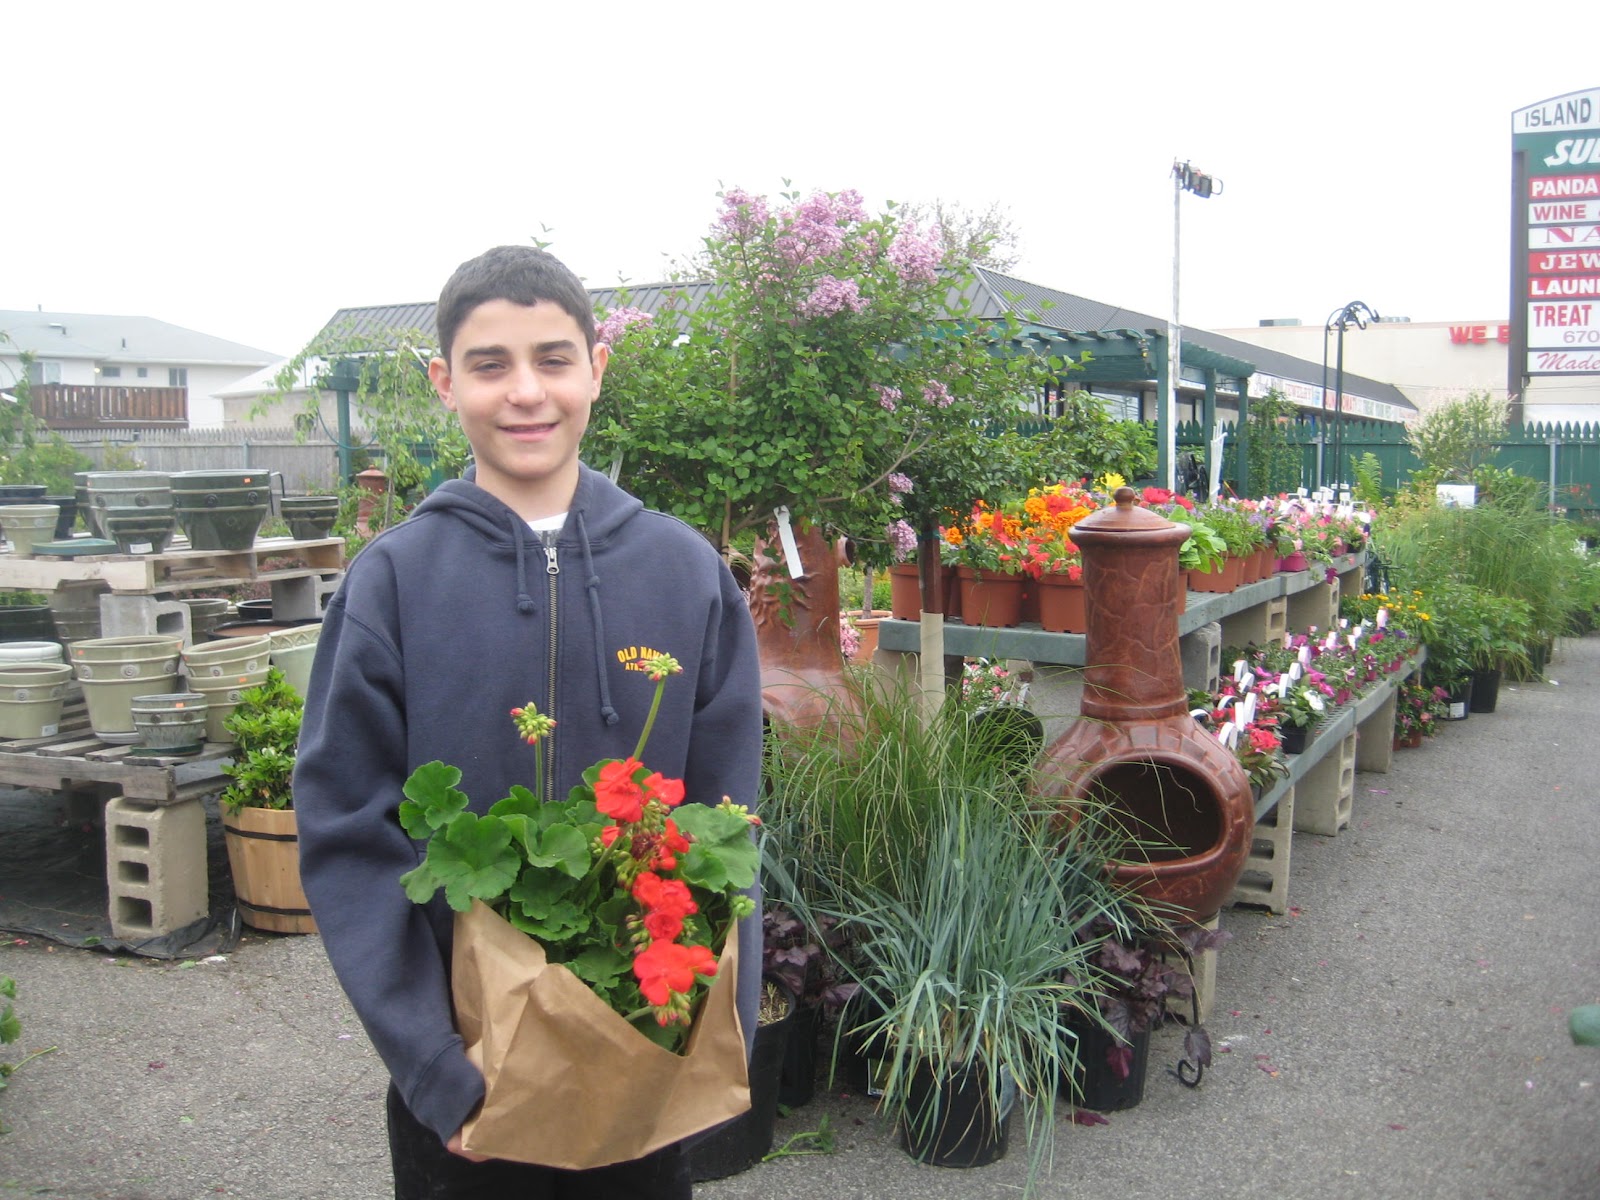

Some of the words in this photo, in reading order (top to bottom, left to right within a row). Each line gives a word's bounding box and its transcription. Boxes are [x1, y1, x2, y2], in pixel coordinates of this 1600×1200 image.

[1525, 97, 1591, 128] ISLAND
[1531, 177, 1598, 197] PANDA
[1533, 204, 1587, 221] WINE
[1539, 253, 1600, 270] JEW
[1531, 279, 1600, 295] LAUN
[1533, 304, 1592, 327] TREAT
[1449, 325, 1488, 345] WE
[617, 646, 638, 663] OLD
